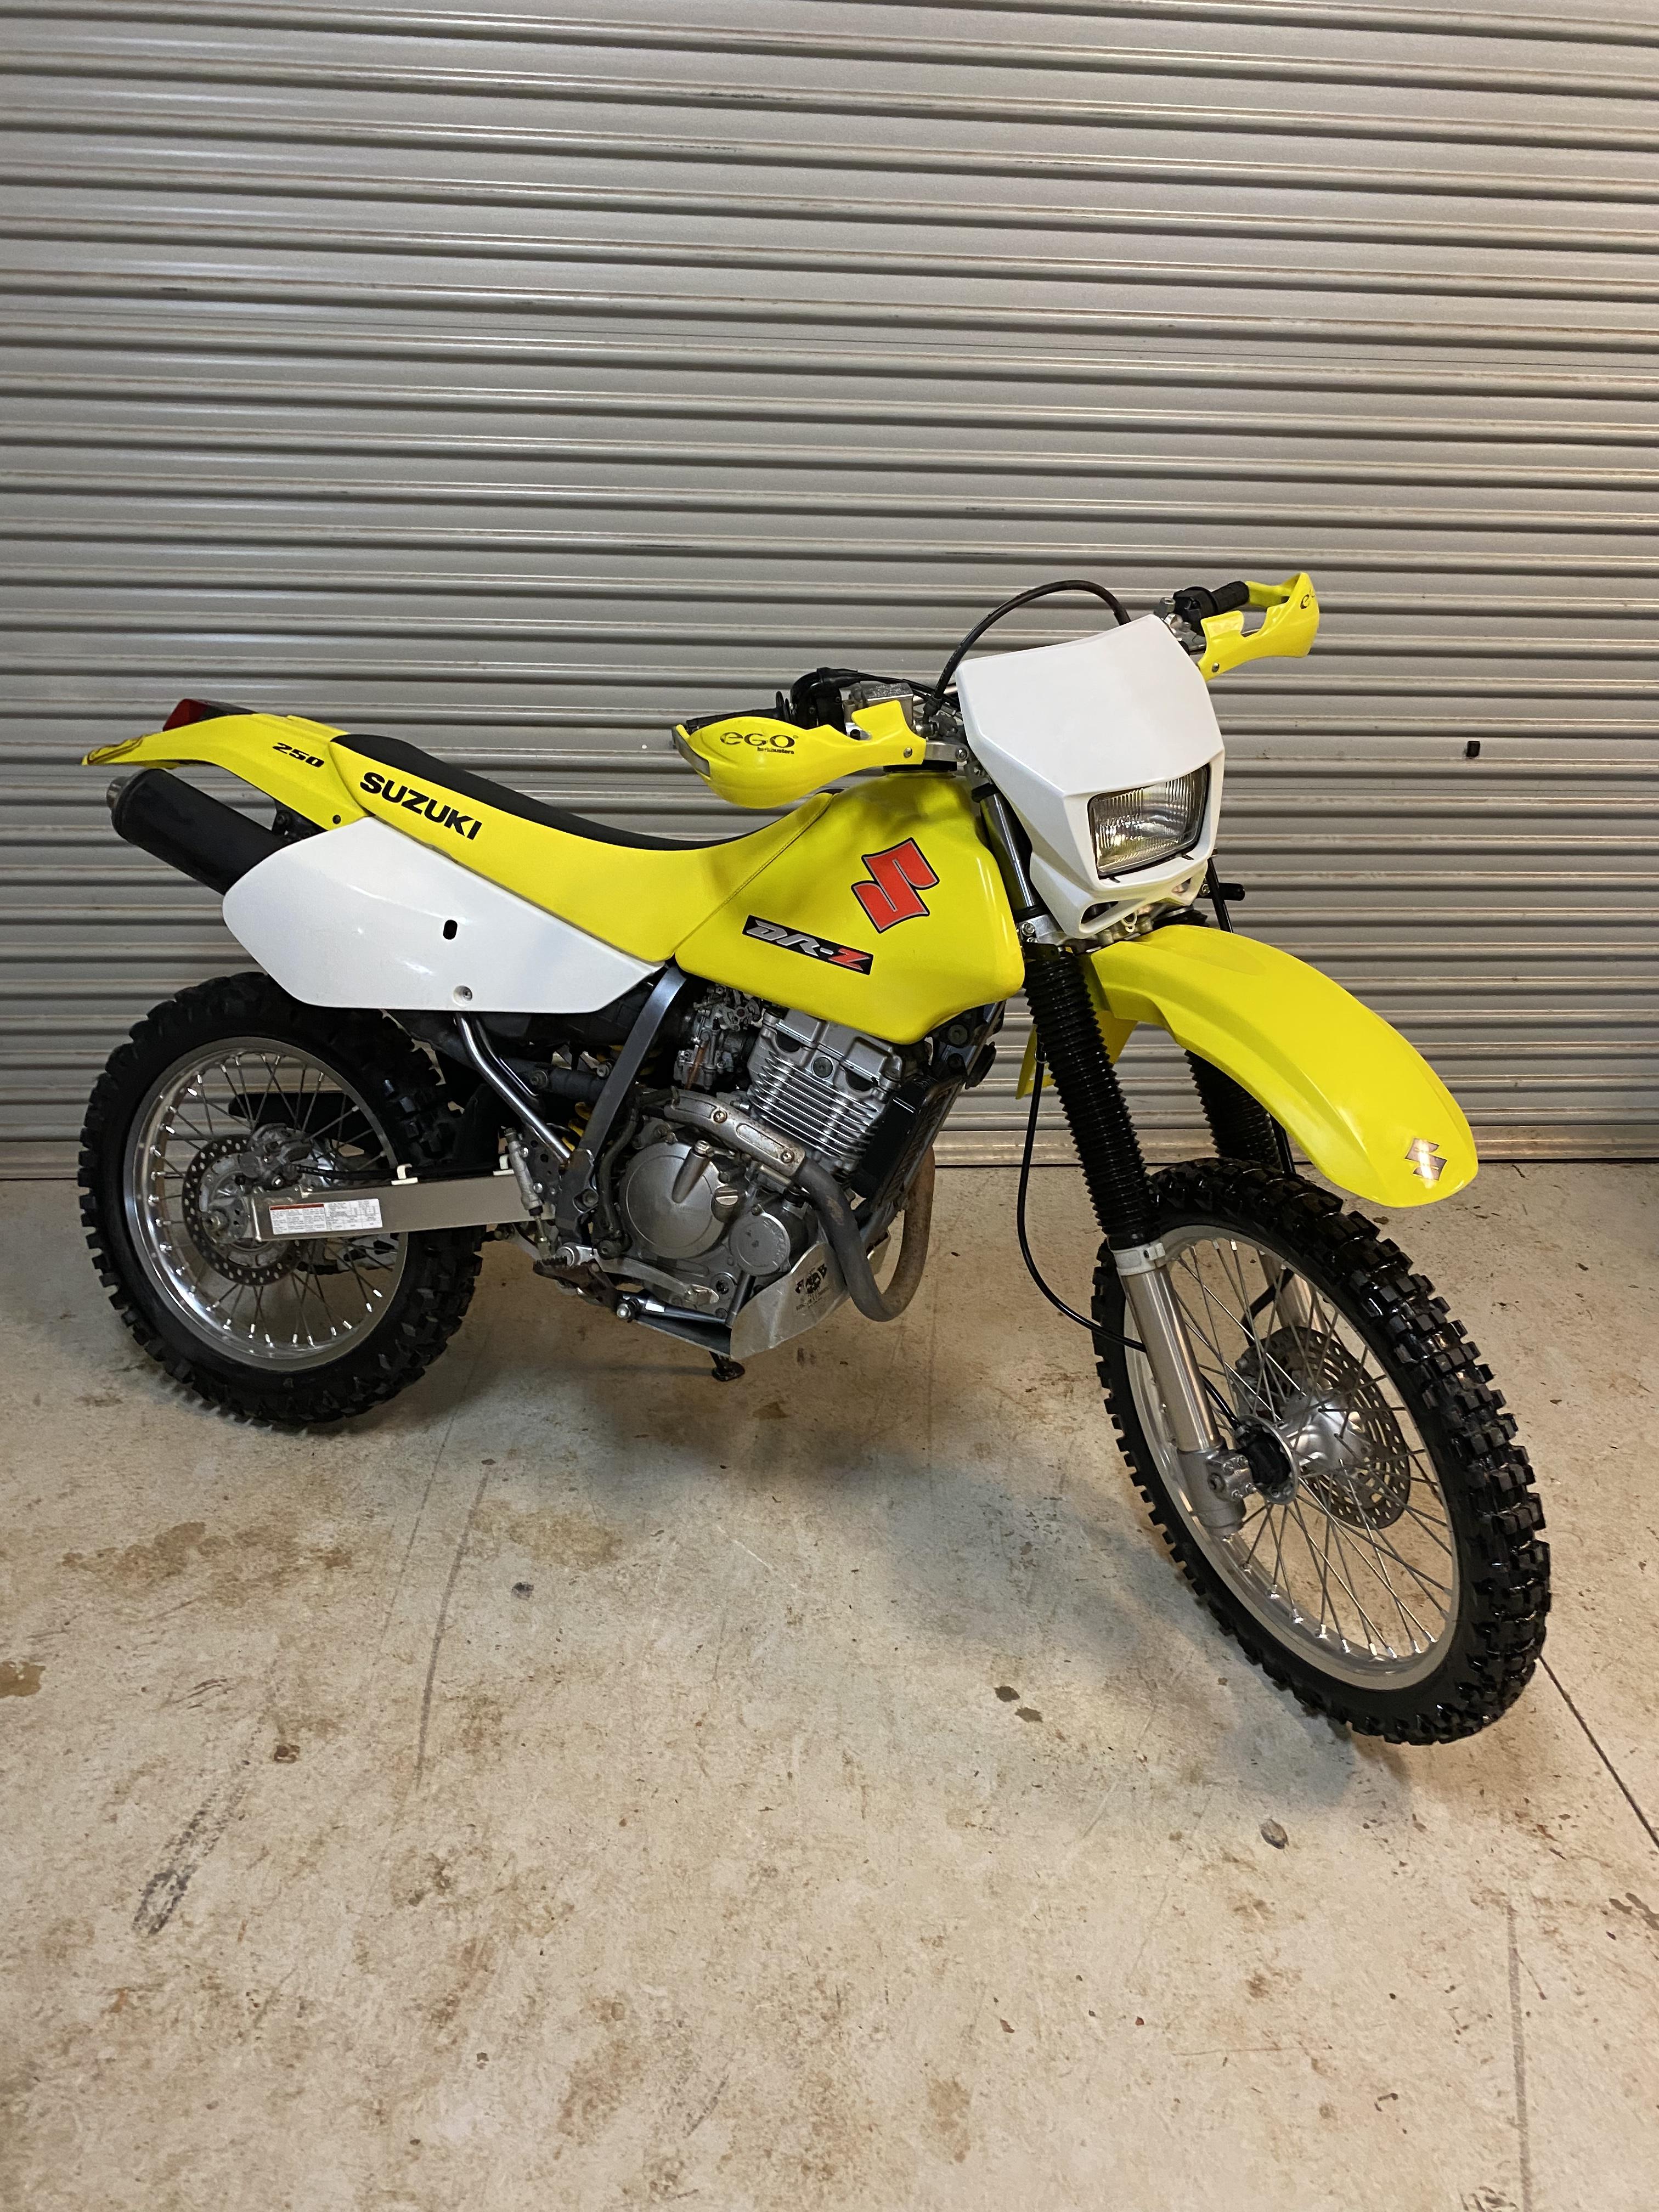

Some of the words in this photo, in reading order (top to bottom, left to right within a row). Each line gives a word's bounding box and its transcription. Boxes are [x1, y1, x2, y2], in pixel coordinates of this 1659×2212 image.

[272, 742, 325, 768] 250
[360, 772, 482, 840] SUZUKI
[746, 919, 870, 972] DR-Z
